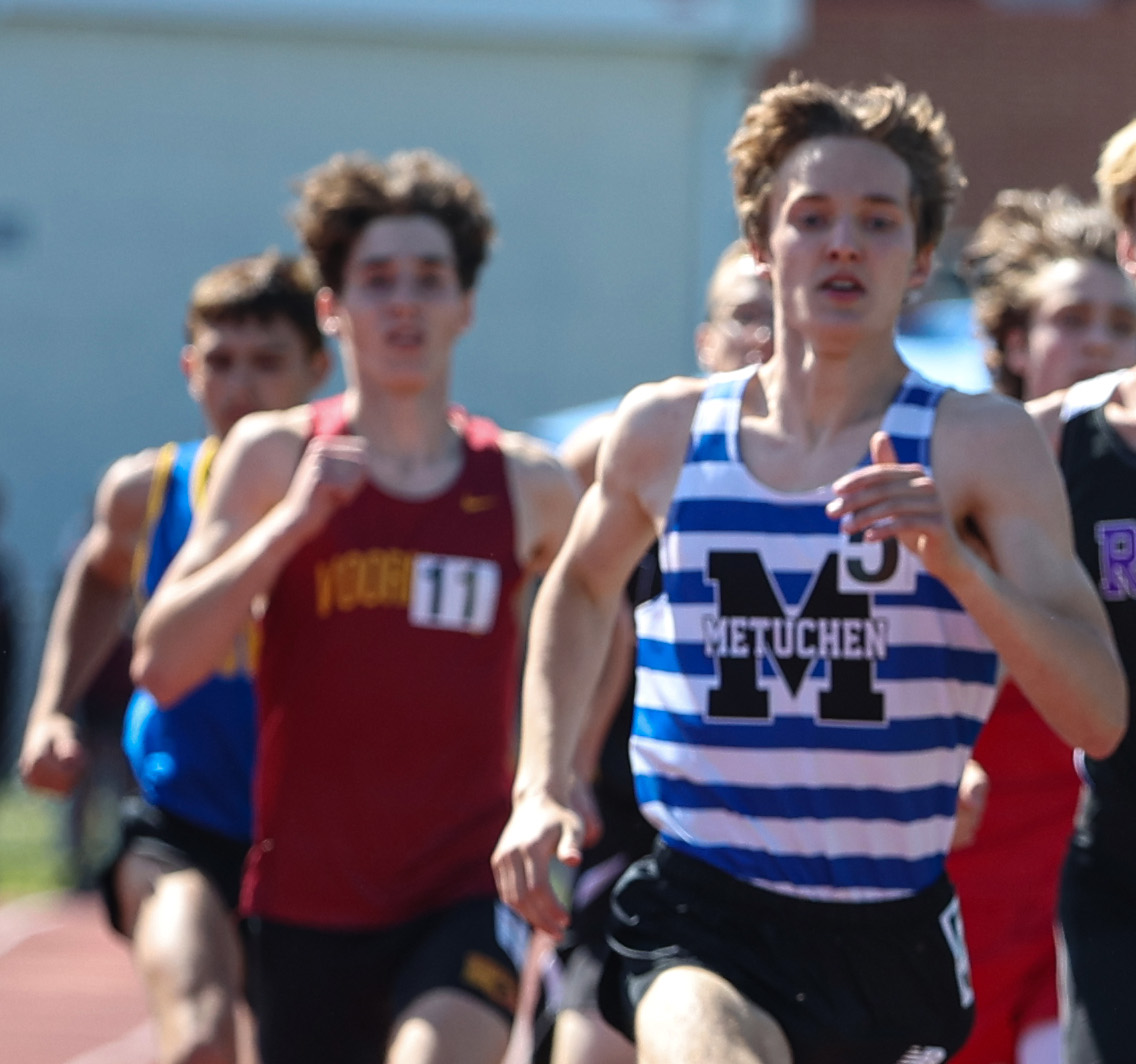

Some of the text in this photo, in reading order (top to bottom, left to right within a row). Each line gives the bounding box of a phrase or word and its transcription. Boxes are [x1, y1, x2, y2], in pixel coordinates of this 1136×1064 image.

[846, 530, 899, 583] 5
[425, 564, 478, 620] 11
[703, 616, 887, 659] METUCHEN
[705, 550, 886, 724] M
